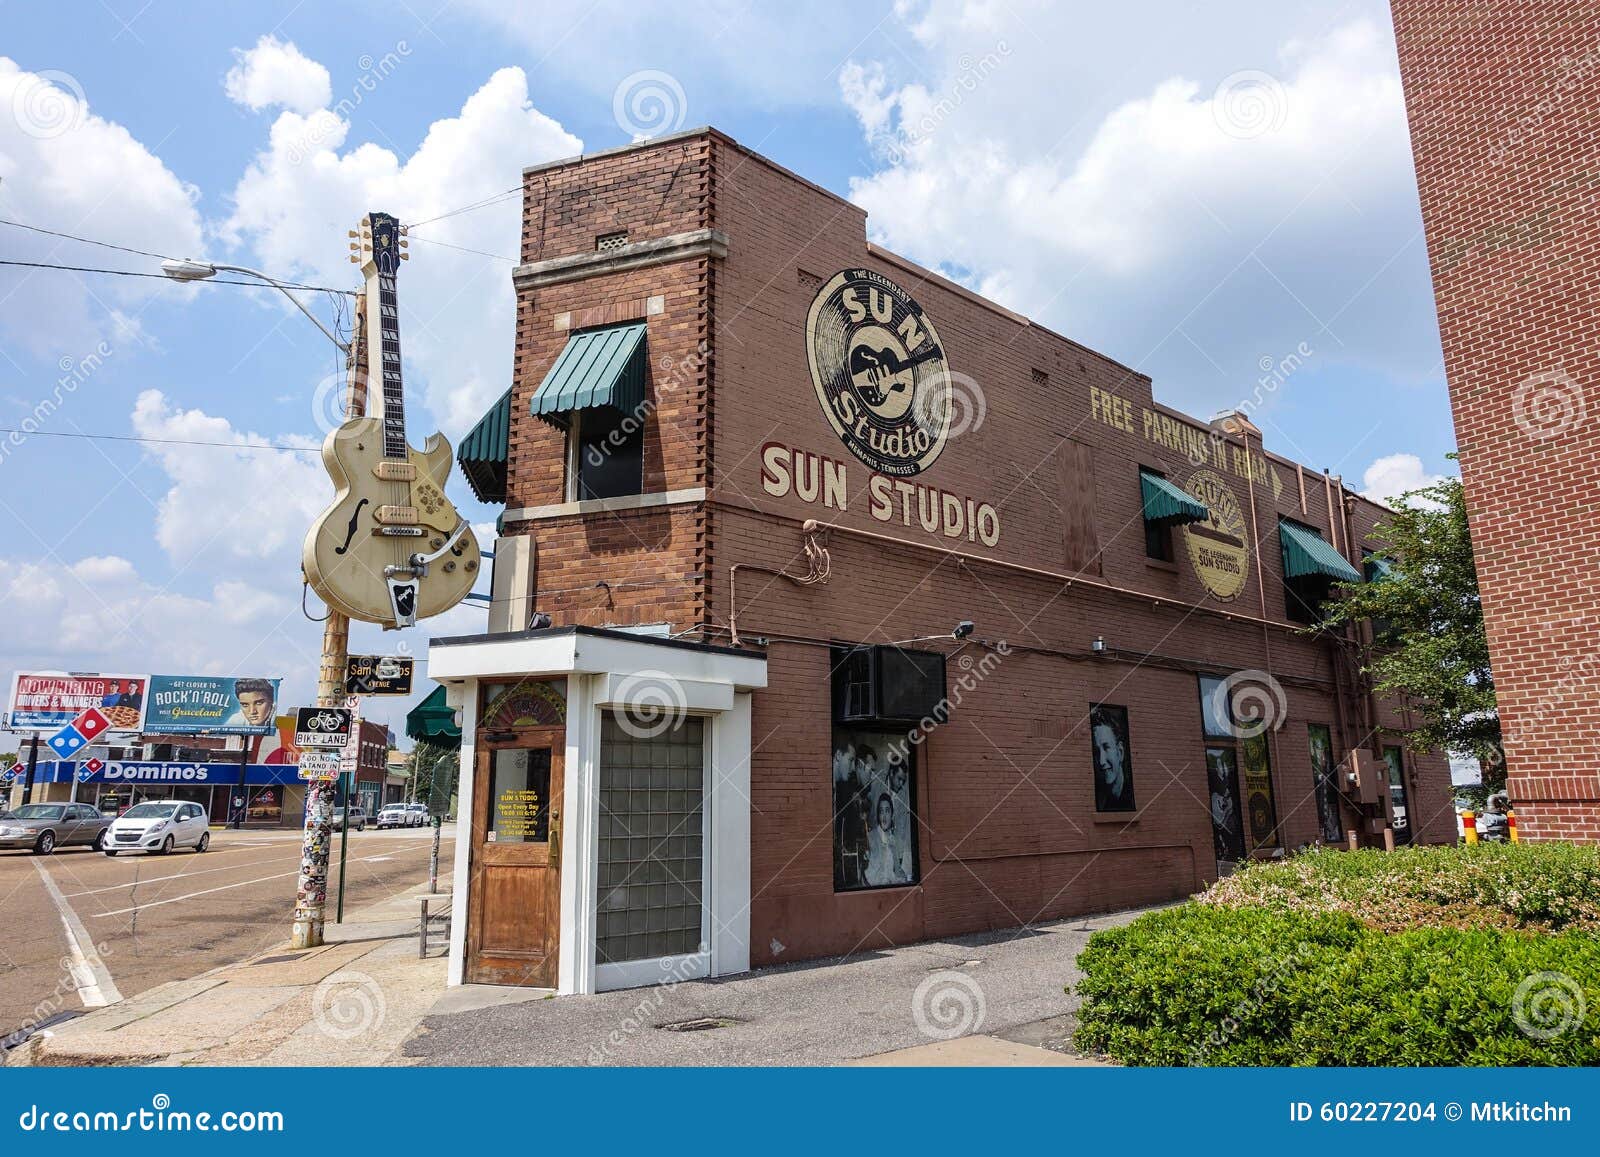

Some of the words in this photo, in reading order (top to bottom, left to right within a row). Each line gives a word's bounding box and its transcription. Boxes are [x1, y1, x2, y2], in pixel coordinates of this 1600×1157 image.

[853, 270, 867, 279] THE
[868, 271, 912, 303] LEGENDARY
[842, 287, 925, 352] SUN
[833, 390, 930, 458] Studio
[1090, 386, 1135, 434] FREE
[1143, 407, 1208, 464] PARKING
[881, 463, 916, 475] TENNESSEE
[761, 442, 848, 511] SUN
[869, 472, 1000, 547] STUDIO
[1199, 547, 1209, 556] THE
[1210, 550, 1238, 562] LEGENDARY
[1199, 555, 1214, 568] SUN
[1215, 560, 1240, 575] STUDIO
[350, 664, 371, 676] Sam
[19, 679, 54, 695] NOW
[55, 680, 104, 696] HIRING
[368, 680, 391, 688] AVENUE
[17, 694, 49, 707] DRIVERS
[51, 695, 59, 708] &
[60, 695, 103, 708] MANAGERS
[172, 706, 223, 719] Graceland
[297, 733, 318, 744] BIKE
[322, 734, 346, 745] LANE
[103, 763, 209, 780] Domino's
